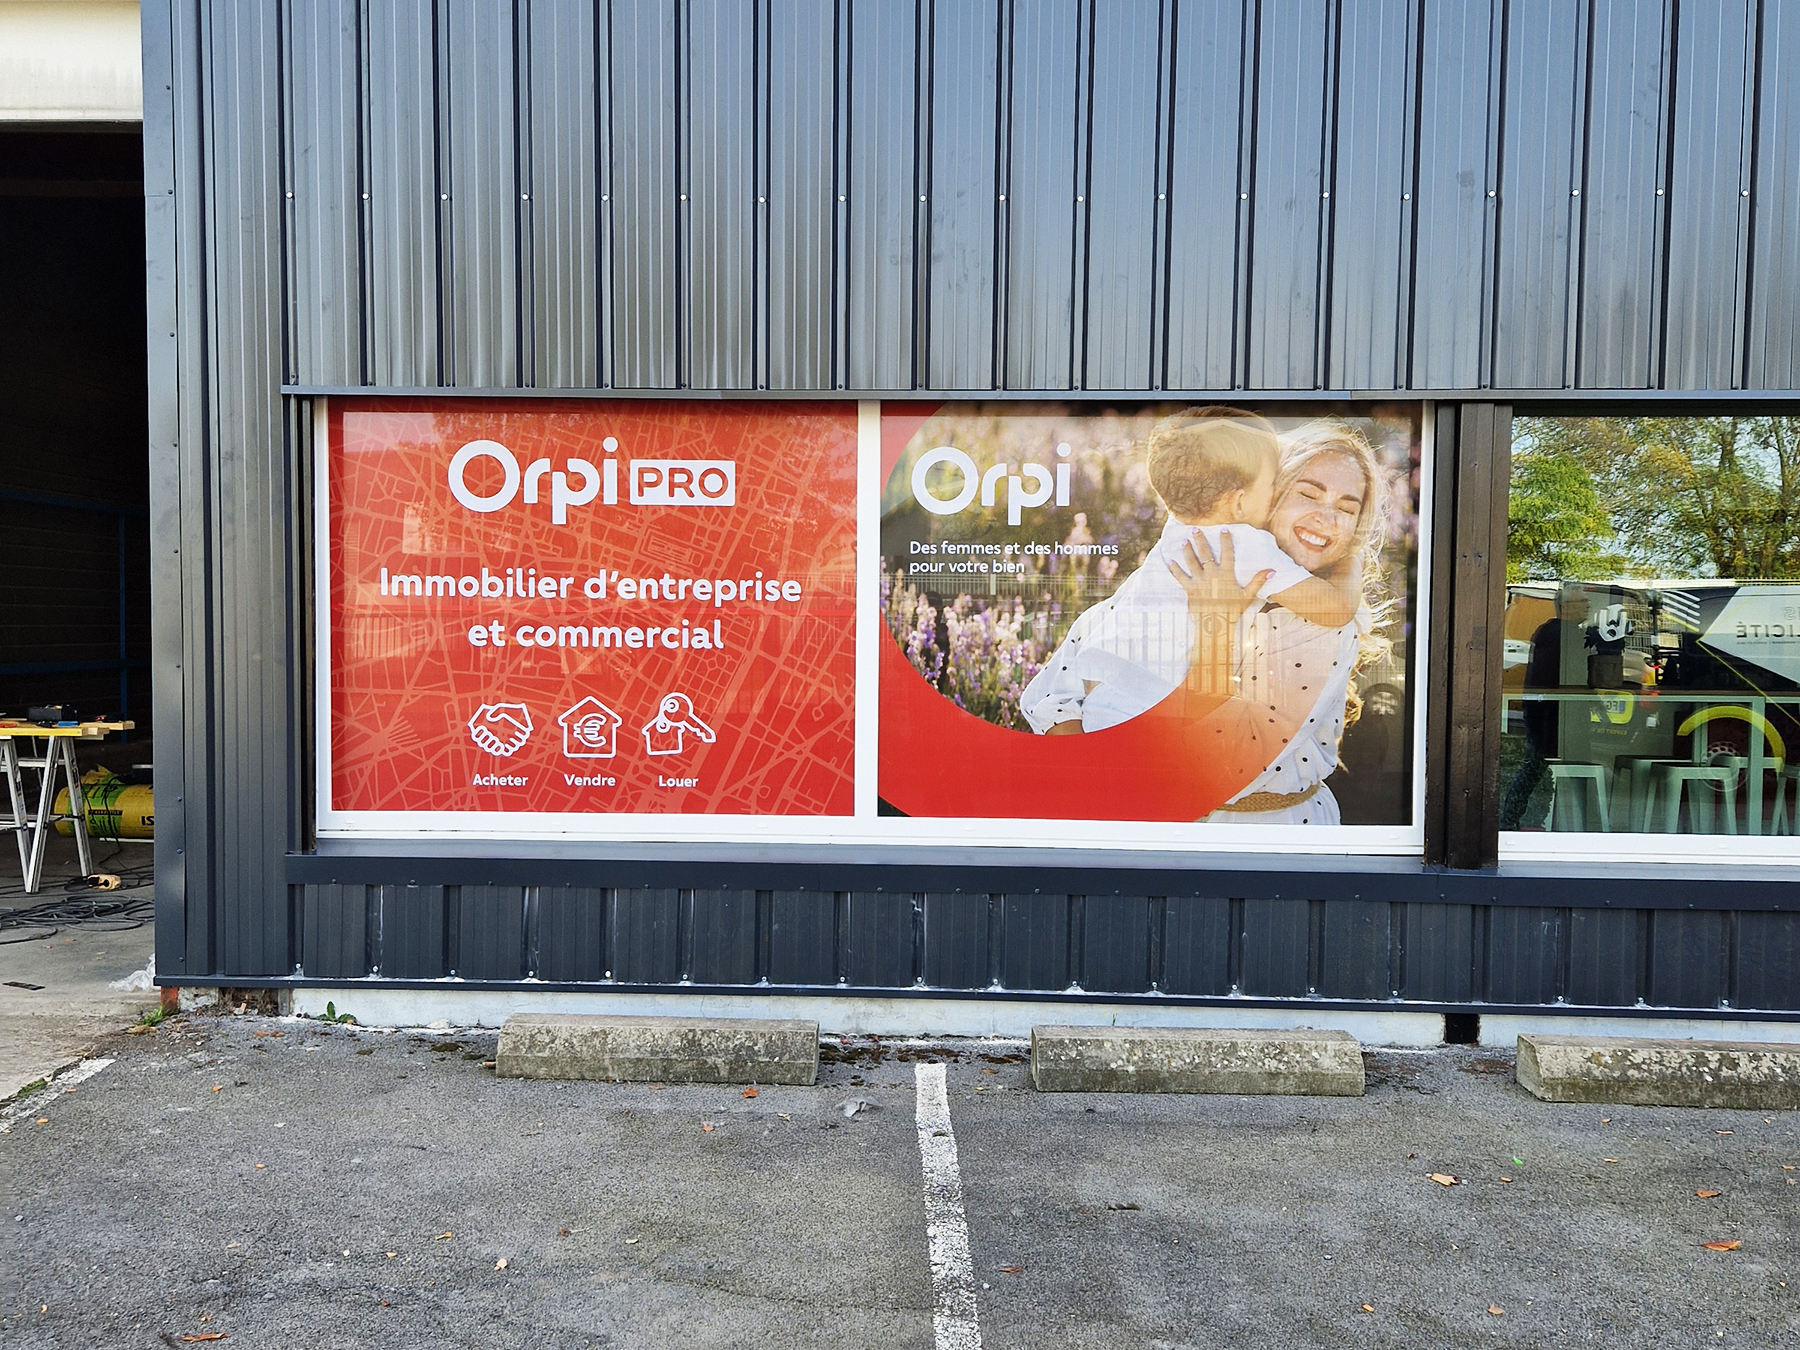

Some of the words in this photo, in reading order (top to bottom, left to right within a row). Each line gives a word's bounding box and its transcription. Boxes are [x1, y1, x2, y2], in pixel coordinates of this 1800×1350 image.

[447, 436, 619, 525] Orpi
[637, 466, 729, 499] PRO
[911, 442, 1071, 526] Orpi
[909, 540, 938, 555] Des
[941, 540, 1001, 555] femmes
[1004, 541, 1021, 555] et
[1024, 541, 1051, 555] des
[1054, 541, 1119, 555] hommes
[909, 559, 945, 575] pour
[948, 559, 989, 573] votre
[992, 559, 1025, 573] bien
[379, 567, 575, 599] Immobilier
[467, 619, 505, 648] et
[515, 619, 724, 650] commercial
[472, 773, 529, 787] Acheter
[563, 773, 616, 787] Vendre
[658, 774, 699, 788] Louer
